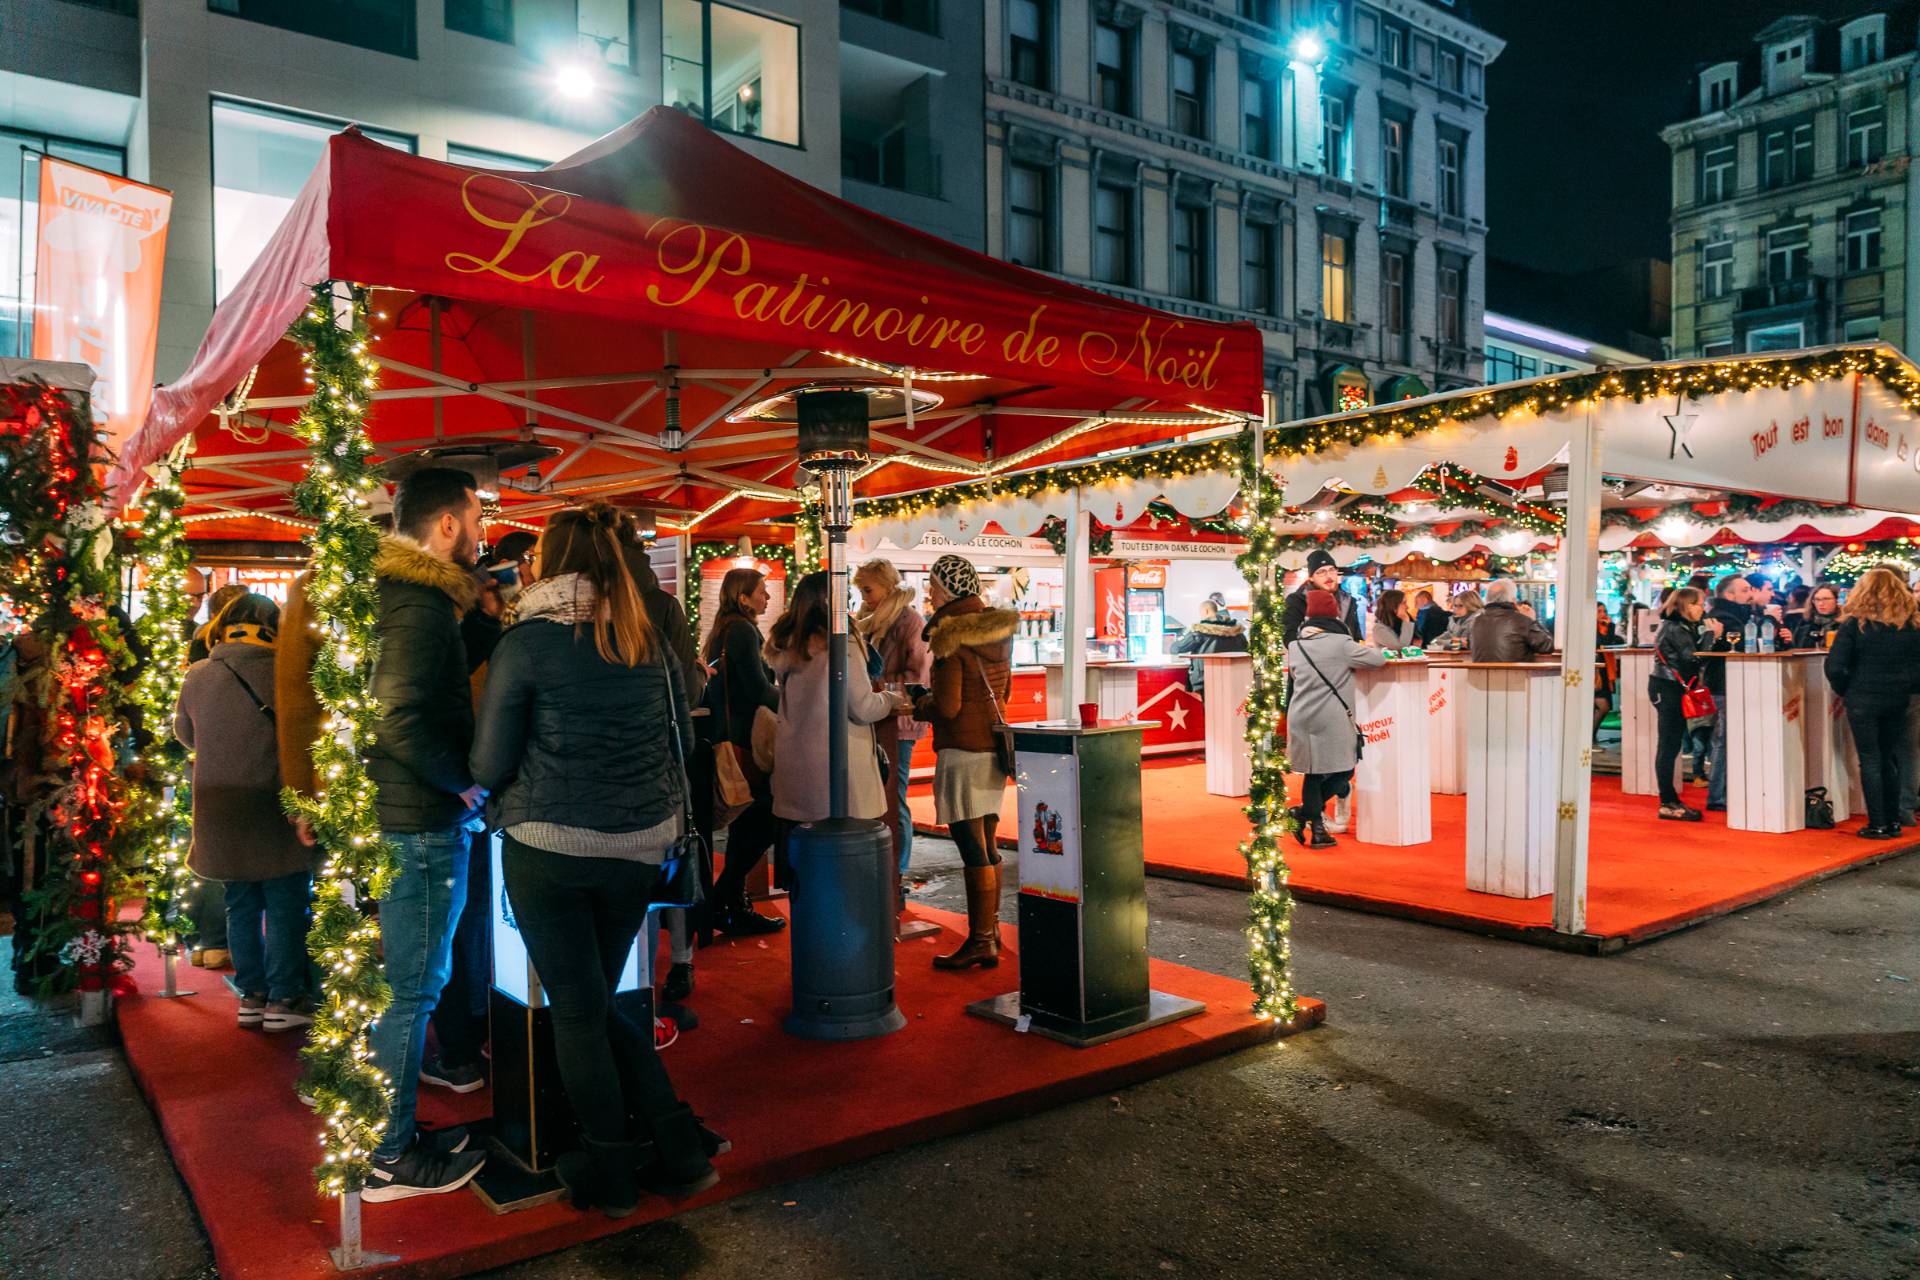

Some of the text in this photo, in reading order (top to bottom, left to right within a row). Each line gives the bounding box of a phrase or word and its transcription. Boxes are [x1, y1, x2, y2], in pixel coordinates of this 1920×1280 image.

[445, 174, 1225, 390] La Patinoire de Noël
[1751, 411, 1844, 459] Tout est bon
[1865, 416, 1889, 450] dans
[931, 536, 950, 545] BON
[977, 538, 987, 547] LE
[988, 539, 1022, 548] COCHON
[1121, 542, 1140, 550] TOUT
[1141, 543, 1153, 551] EST
[1155, 543, 1169, 551] BON
[1171, 544, 1189, 552] DANS
[1199, 545, 1226, 553] COCHON
[1367, 730, 1391, 744] Noël
